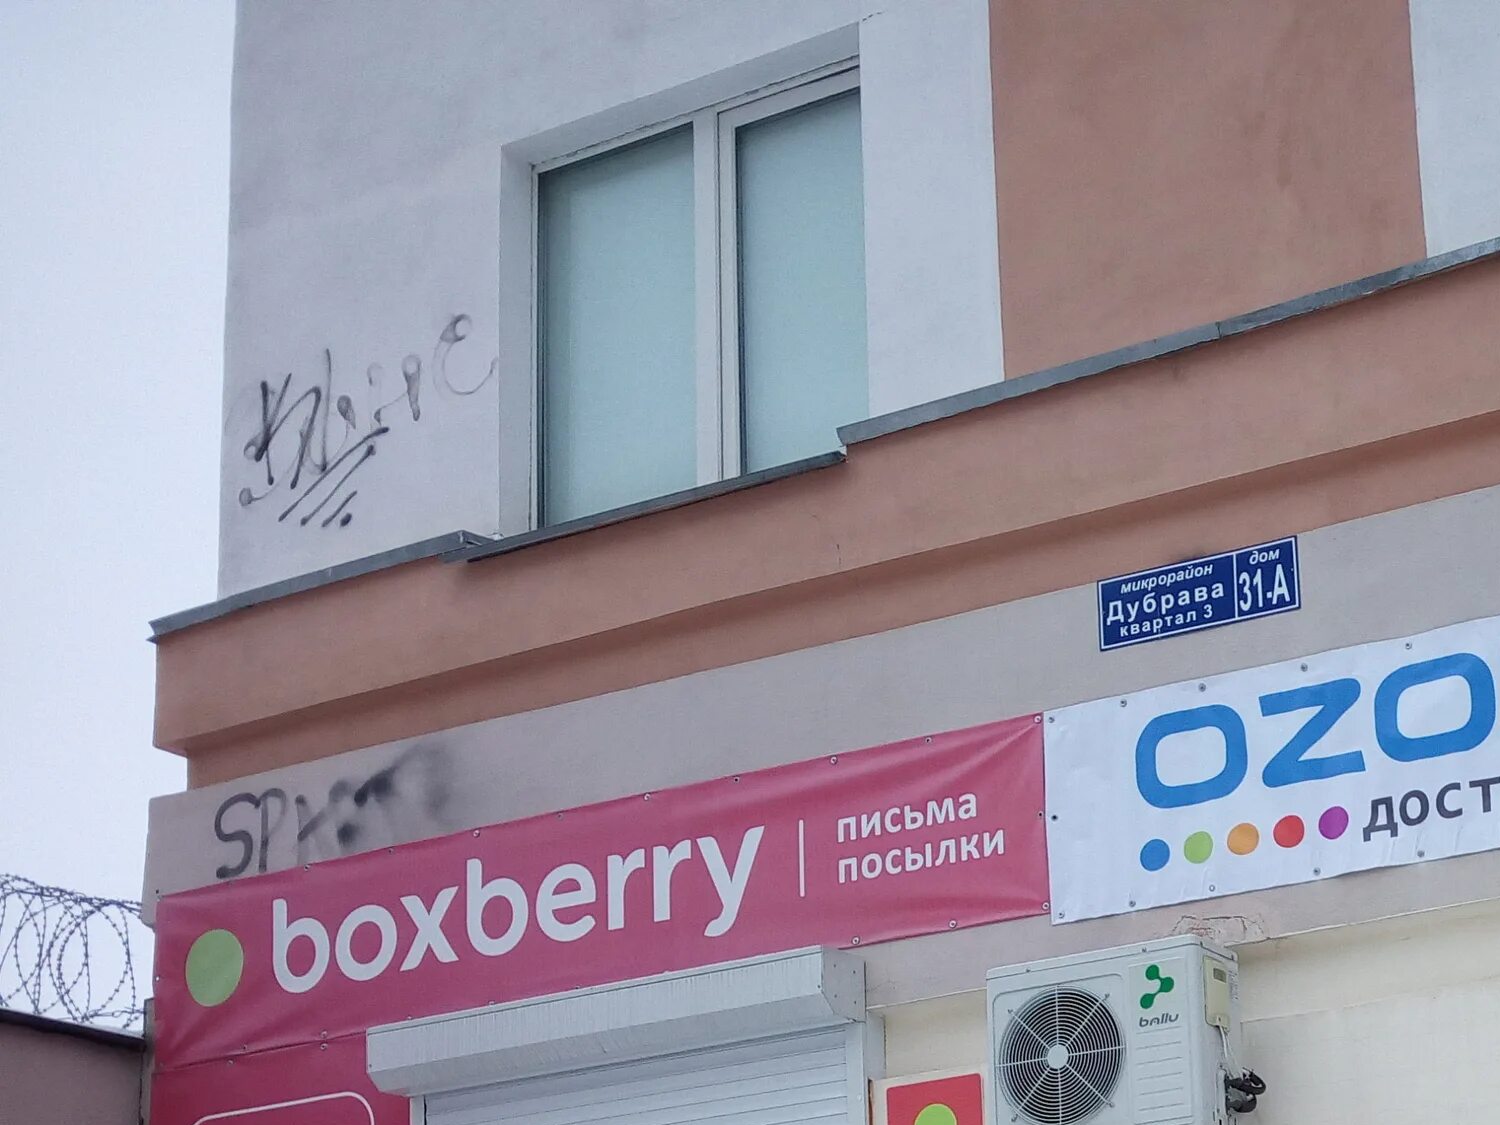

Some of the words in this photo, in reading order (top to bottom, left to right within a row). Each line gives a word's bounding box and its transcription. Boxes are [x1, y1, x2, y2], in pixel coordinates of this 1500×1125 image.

[1249, 547, 1280, 565] дом
[1120, 563, 1213, 594] микрорайон
[1106, 582, 1224, 625] Дубрава
[1120, 610, 1196, 638] квартал
[1203, 604, 1213, 618] 3
[836, 788, 979, 845] письма
[837, 828, 1005, 885] посылки
[271, 826, 764, 995] boxberry
